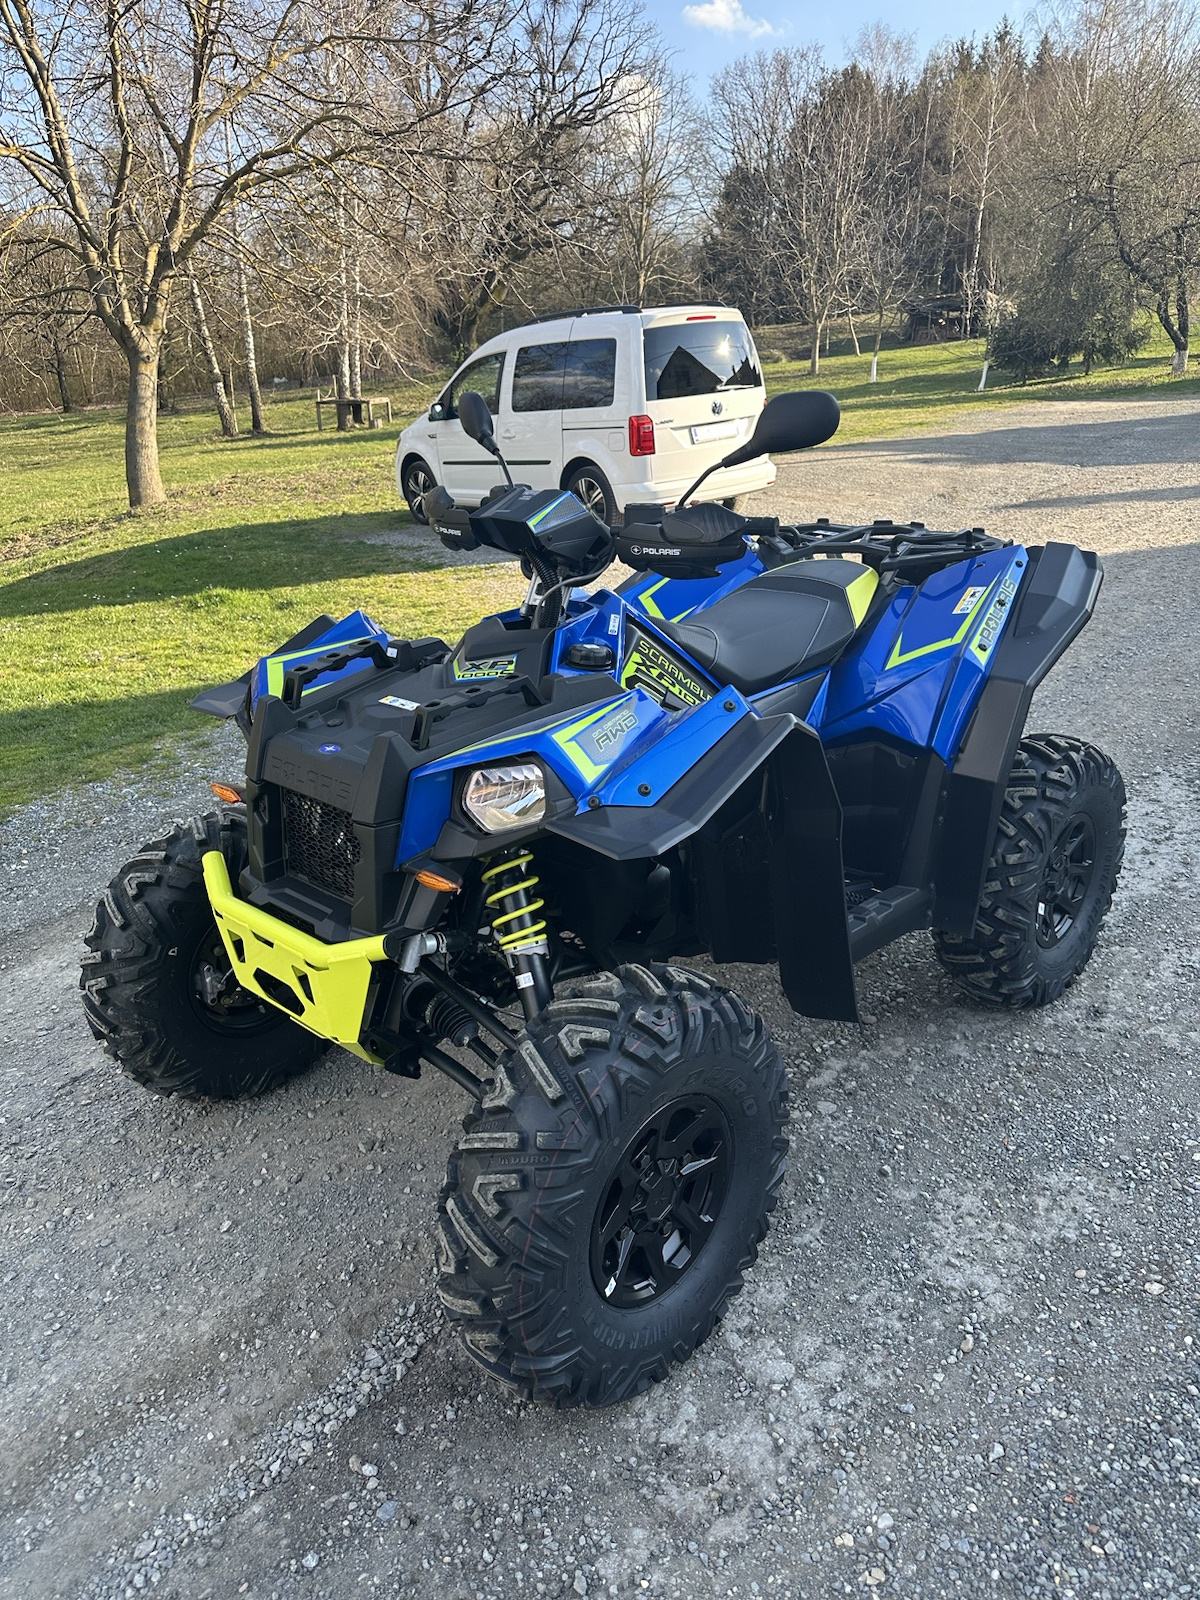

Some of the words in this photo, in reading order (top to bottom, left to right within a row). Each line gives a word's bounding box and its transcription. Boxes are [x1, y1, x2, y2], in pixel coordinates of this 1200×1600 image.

[439, 526, 462, 536] POLARIS
[642, 547, 681, 556] POLARIS
[980, 578, 1017, 642] POLARIS
[462, 660, 514, 672] XP
[594, 712, 639, 752] AWD
[271, 755, 353, 800] POLARIS
